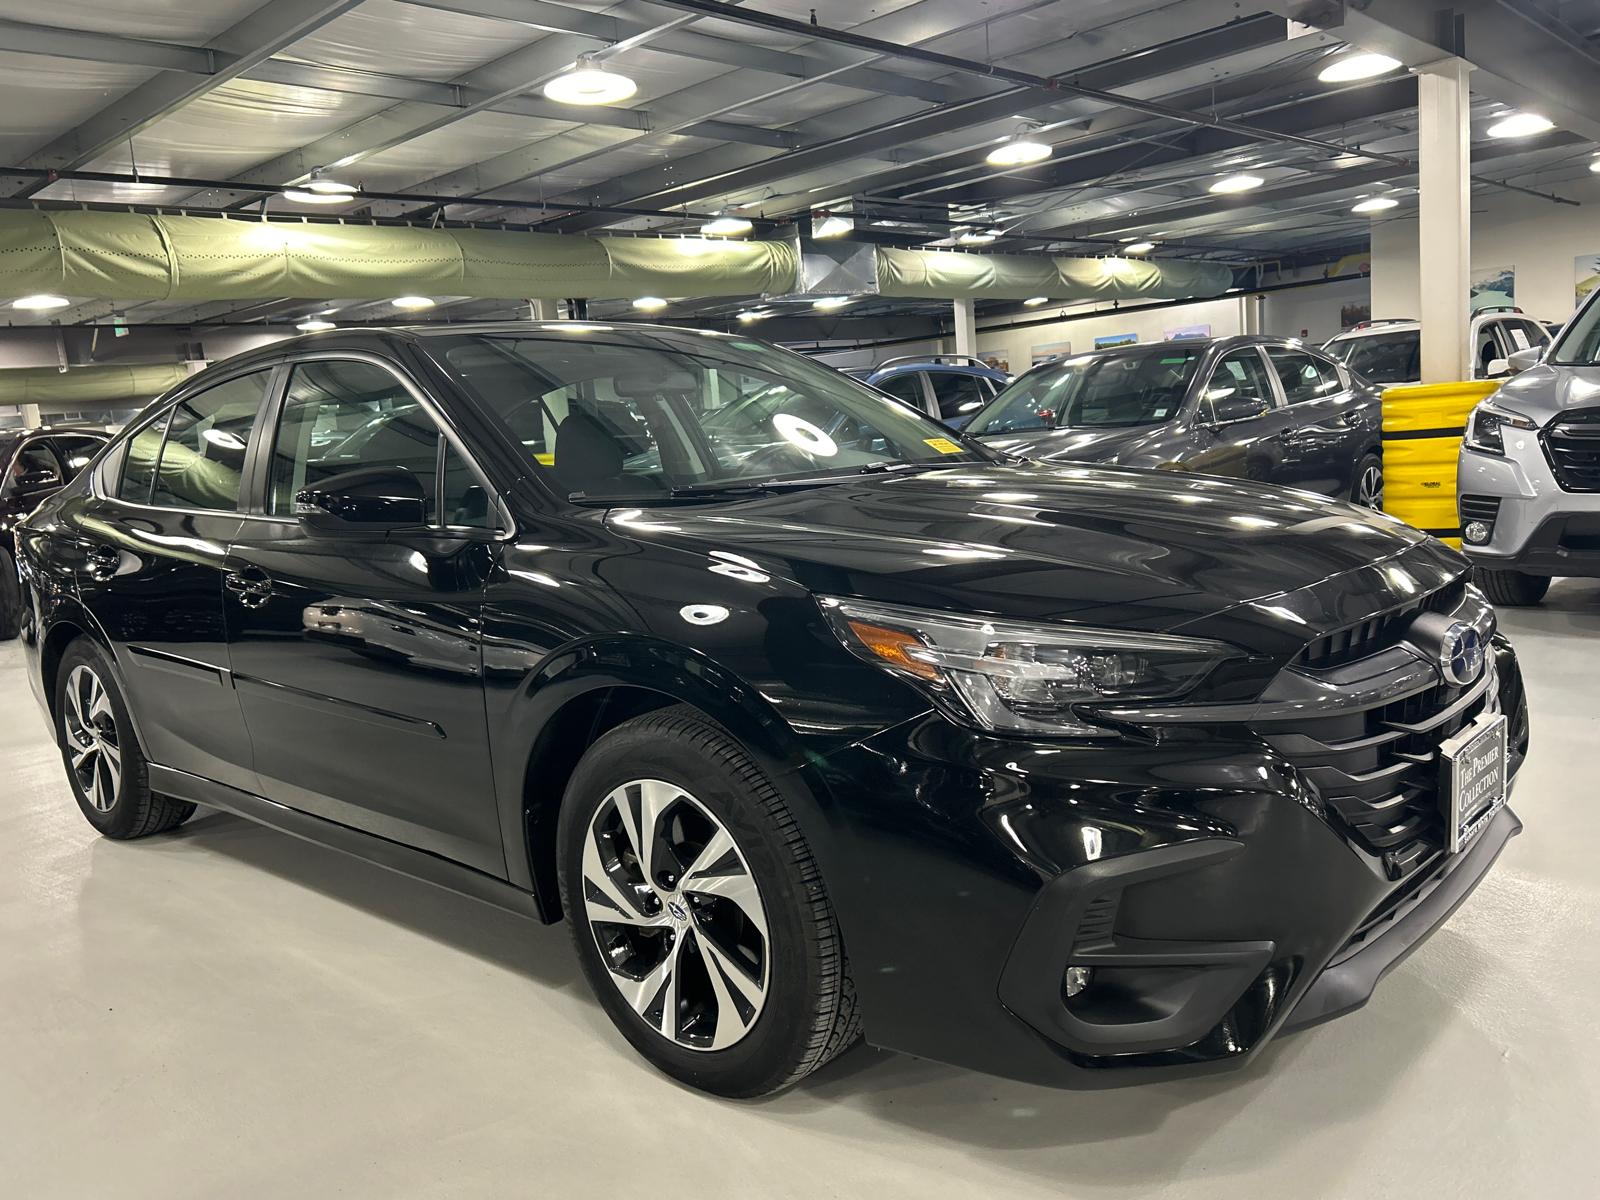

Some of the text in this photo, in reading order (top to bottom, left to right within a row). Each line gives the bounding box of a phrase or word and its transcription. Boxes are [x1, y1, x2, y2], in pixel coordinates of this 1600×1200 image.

[1459, 766, 1499, 813] COLLECTION
[1460, 746, 1499, 789] THE PREMIER
